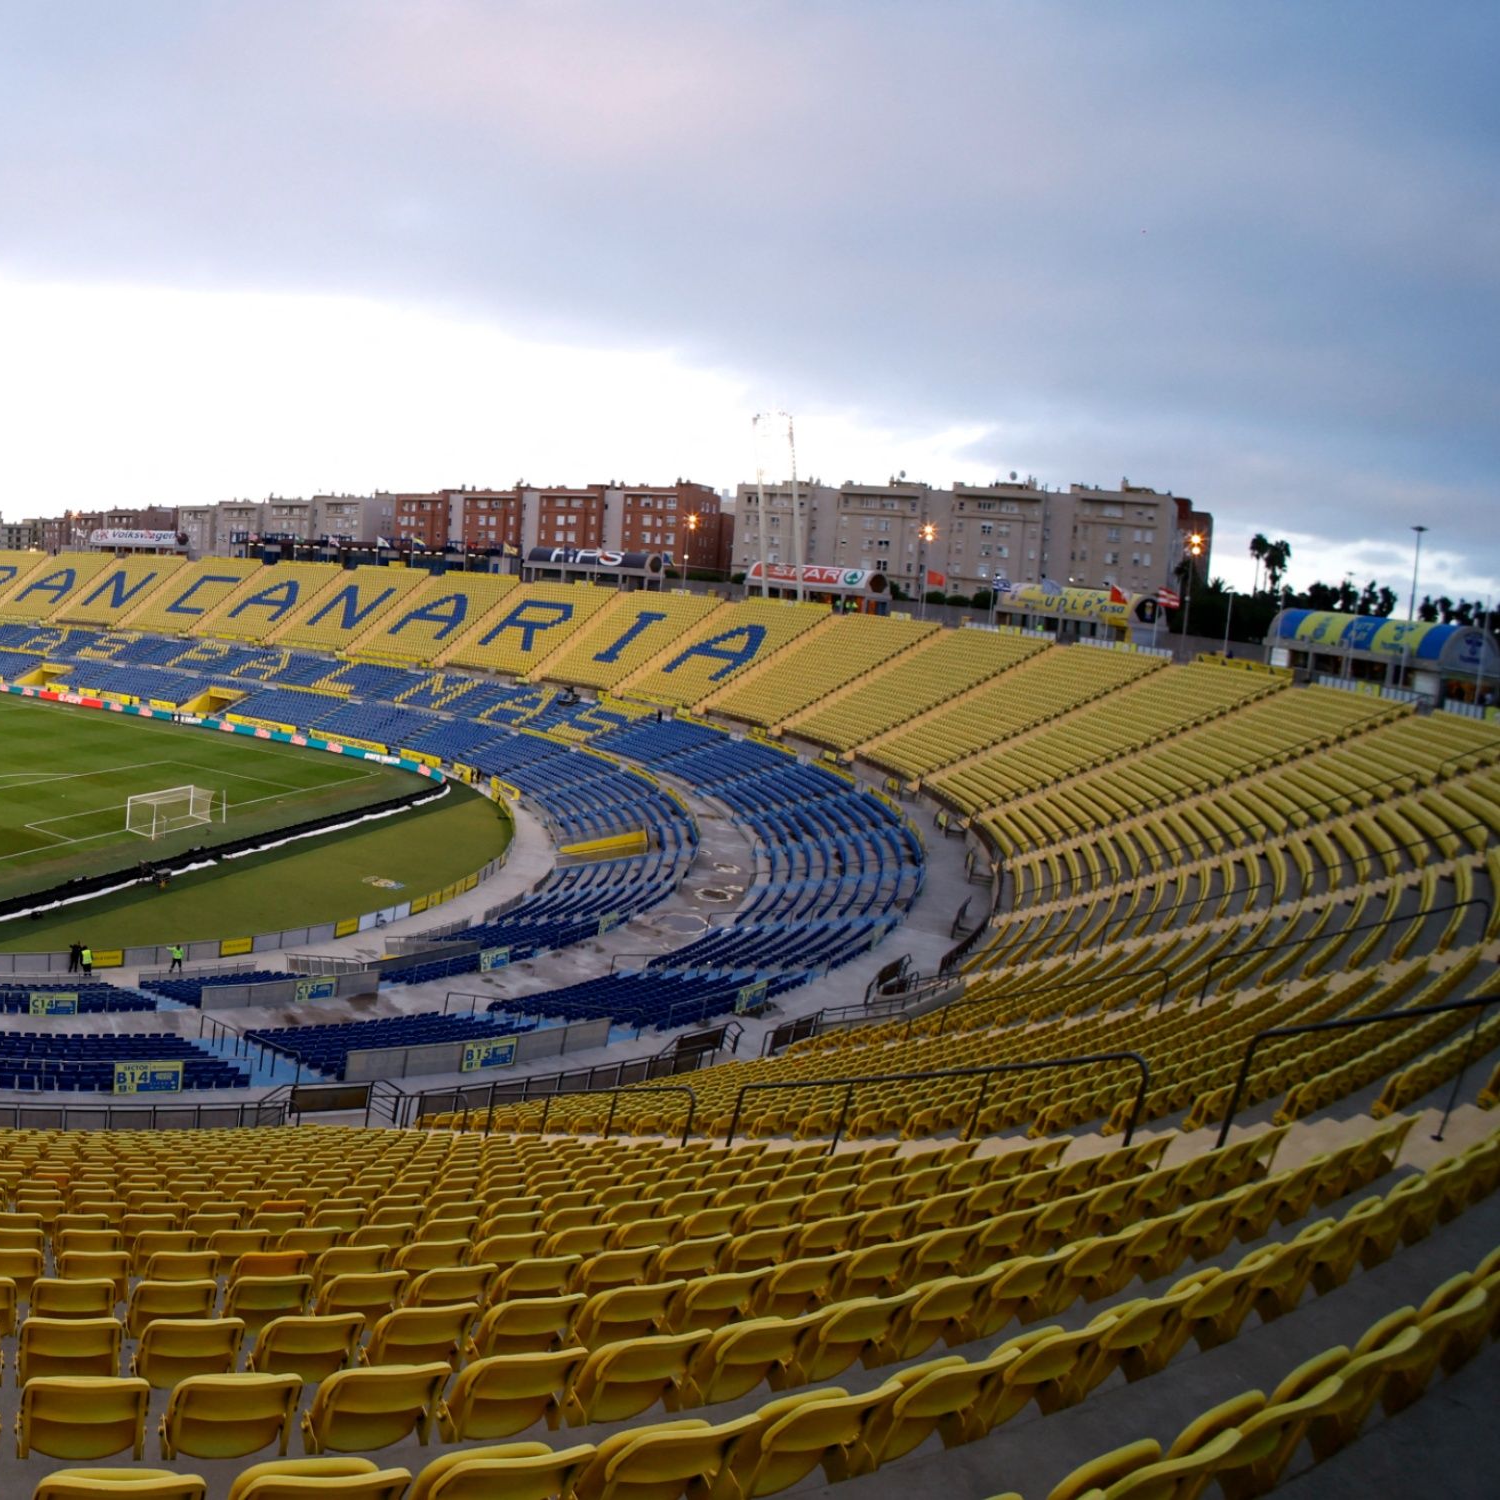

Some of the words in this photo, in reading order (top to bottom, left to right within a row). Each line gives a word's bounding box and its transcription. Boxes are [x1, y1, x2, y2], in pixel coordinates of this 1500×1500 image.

[165, 575, 768, 682] CANARIA
[466, 1048, 490, 1061] B15
[117, 1071, 148, 1084] B14
